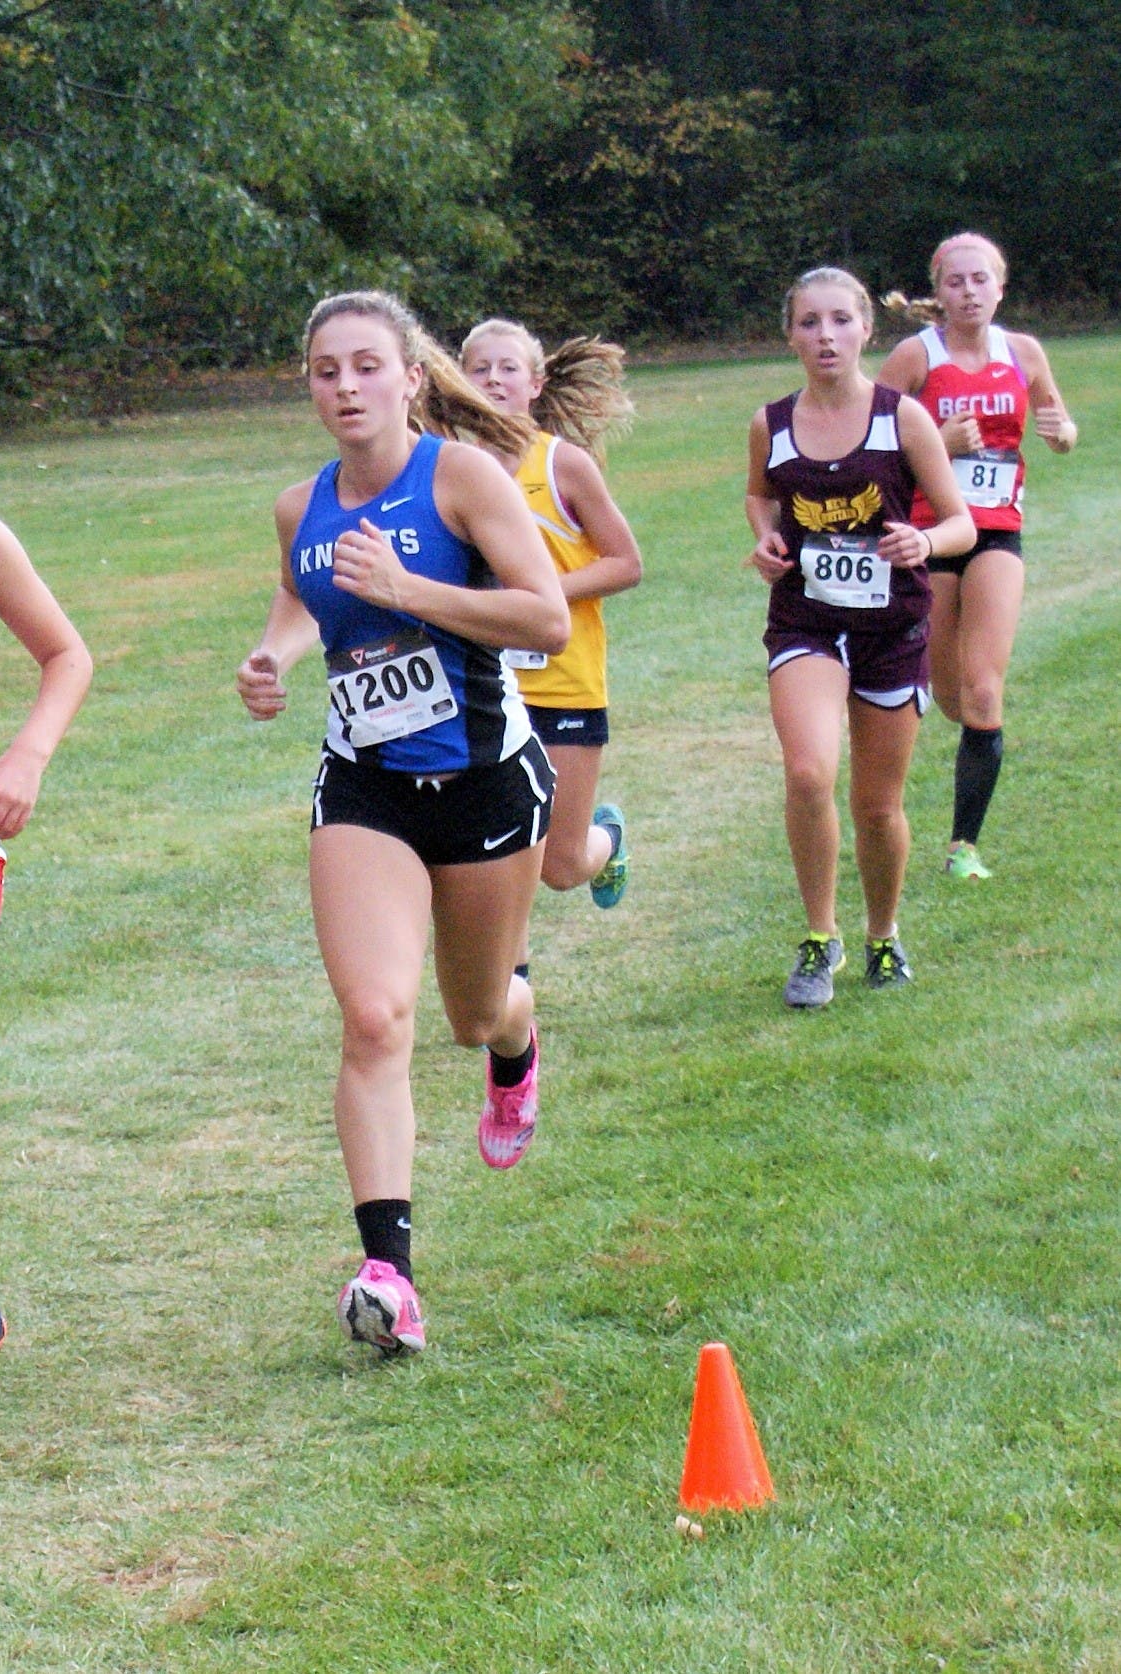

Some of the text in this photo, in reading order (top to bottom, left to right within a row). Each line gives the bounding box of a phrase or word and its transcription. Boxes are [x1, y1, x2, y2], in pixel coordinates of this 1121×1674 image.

[972, 465, 997, 488] 81
[300, 528, 419, 574] KNTS
[815, 554, 873, 583] 806
[337, 656, 434, 716] 1200
